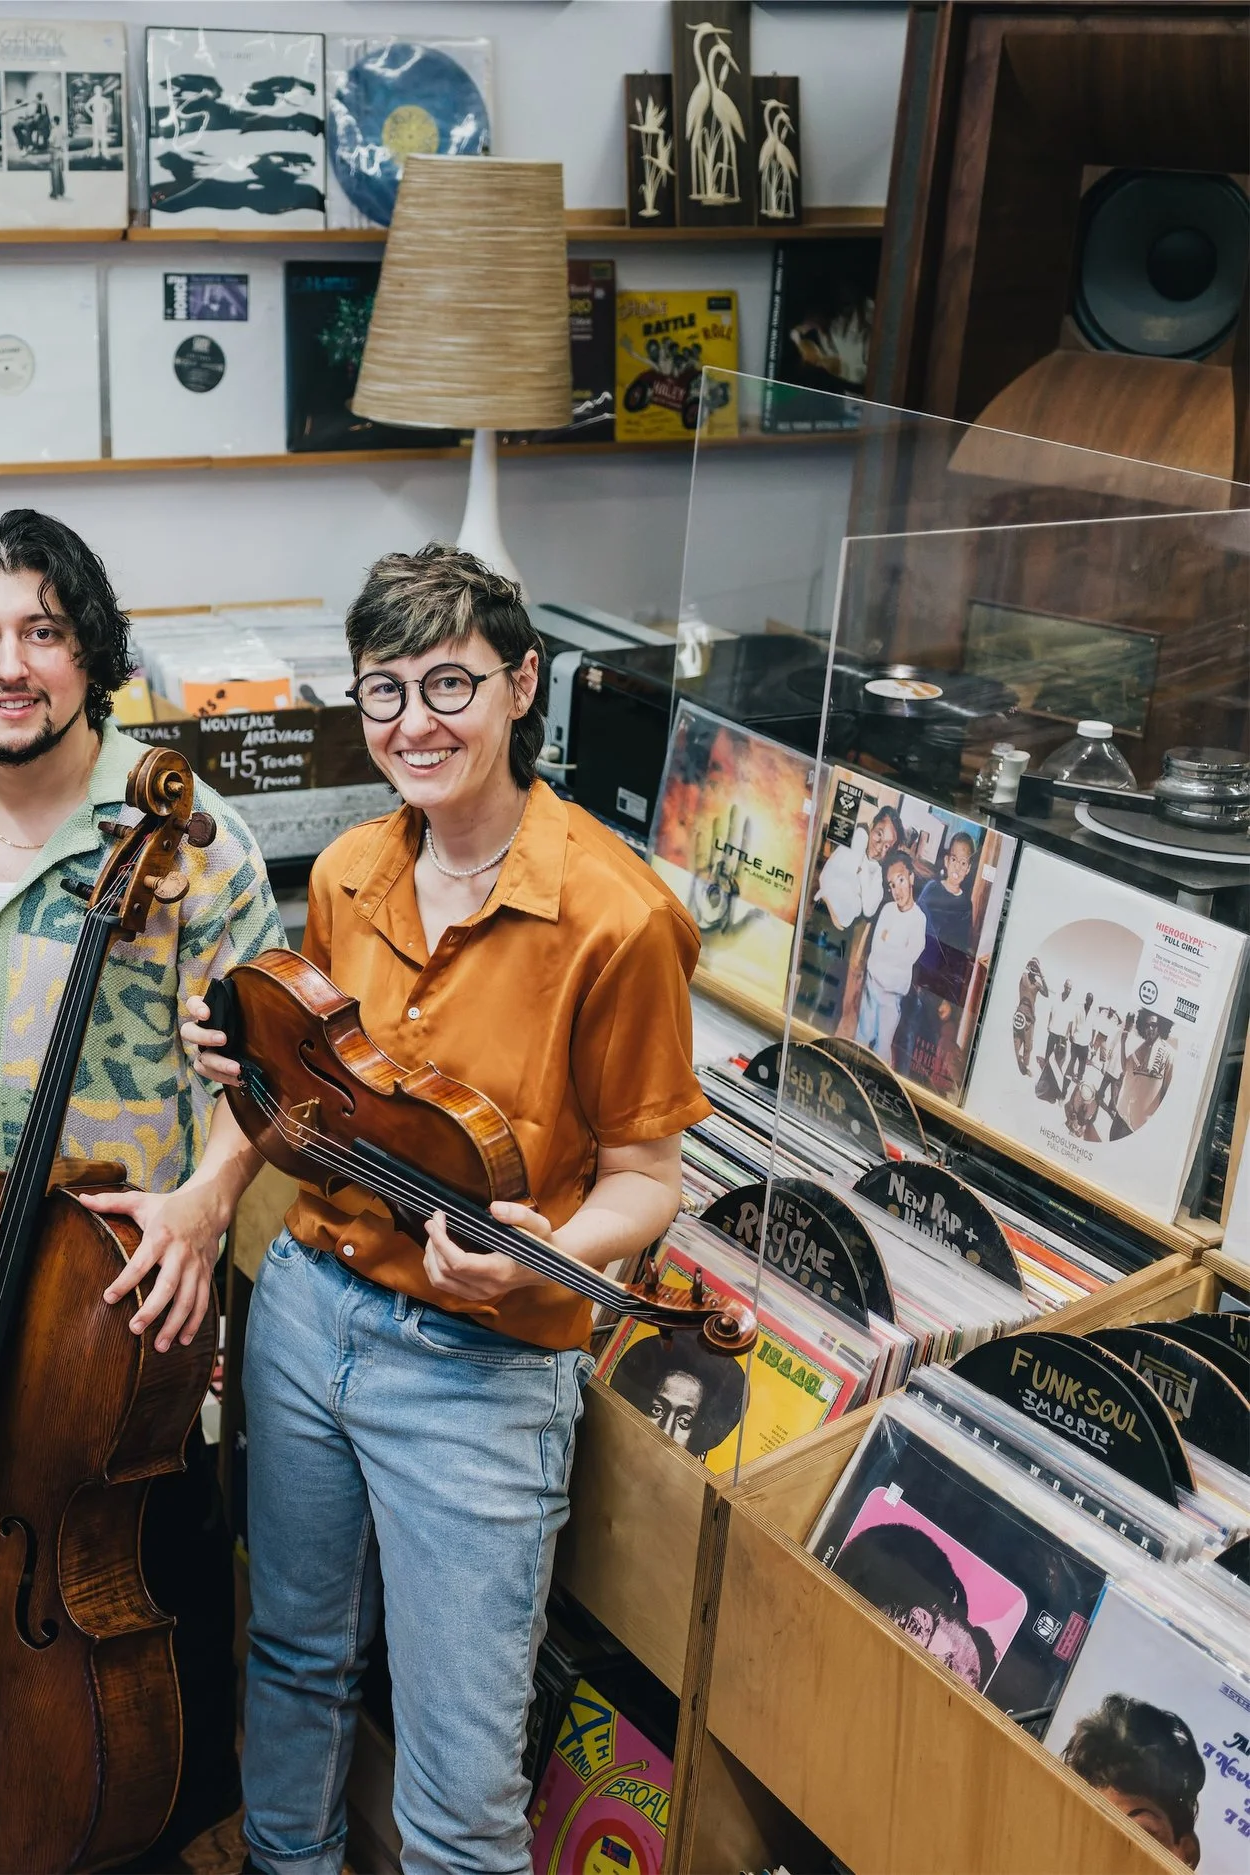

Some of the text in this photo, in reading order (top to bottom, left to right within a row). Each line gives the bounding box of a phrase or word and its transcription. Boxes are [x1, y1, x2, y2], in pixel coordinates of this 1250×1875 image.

[643, 312, 697, 336] RATTLE
[120, 725, 181, 741] RRIVALS
[200, 713, 276, 733] NOUVEAUX
[242, 729, 315, 747] ARRIVAGES
[220, 750, 257, 779] 45
[714, 837, 763, 871] LITTLE
[1155, 921, 1218, 951] HIEROGLYP
[1181, 943, 1205, 957] CIRCL
[1039, 1125, 1094, 1162] HIEROGLYPHICS
[772, 1194, 814, 1231] NEW
[1029, 1463, 1152, 1550] WOMACK
